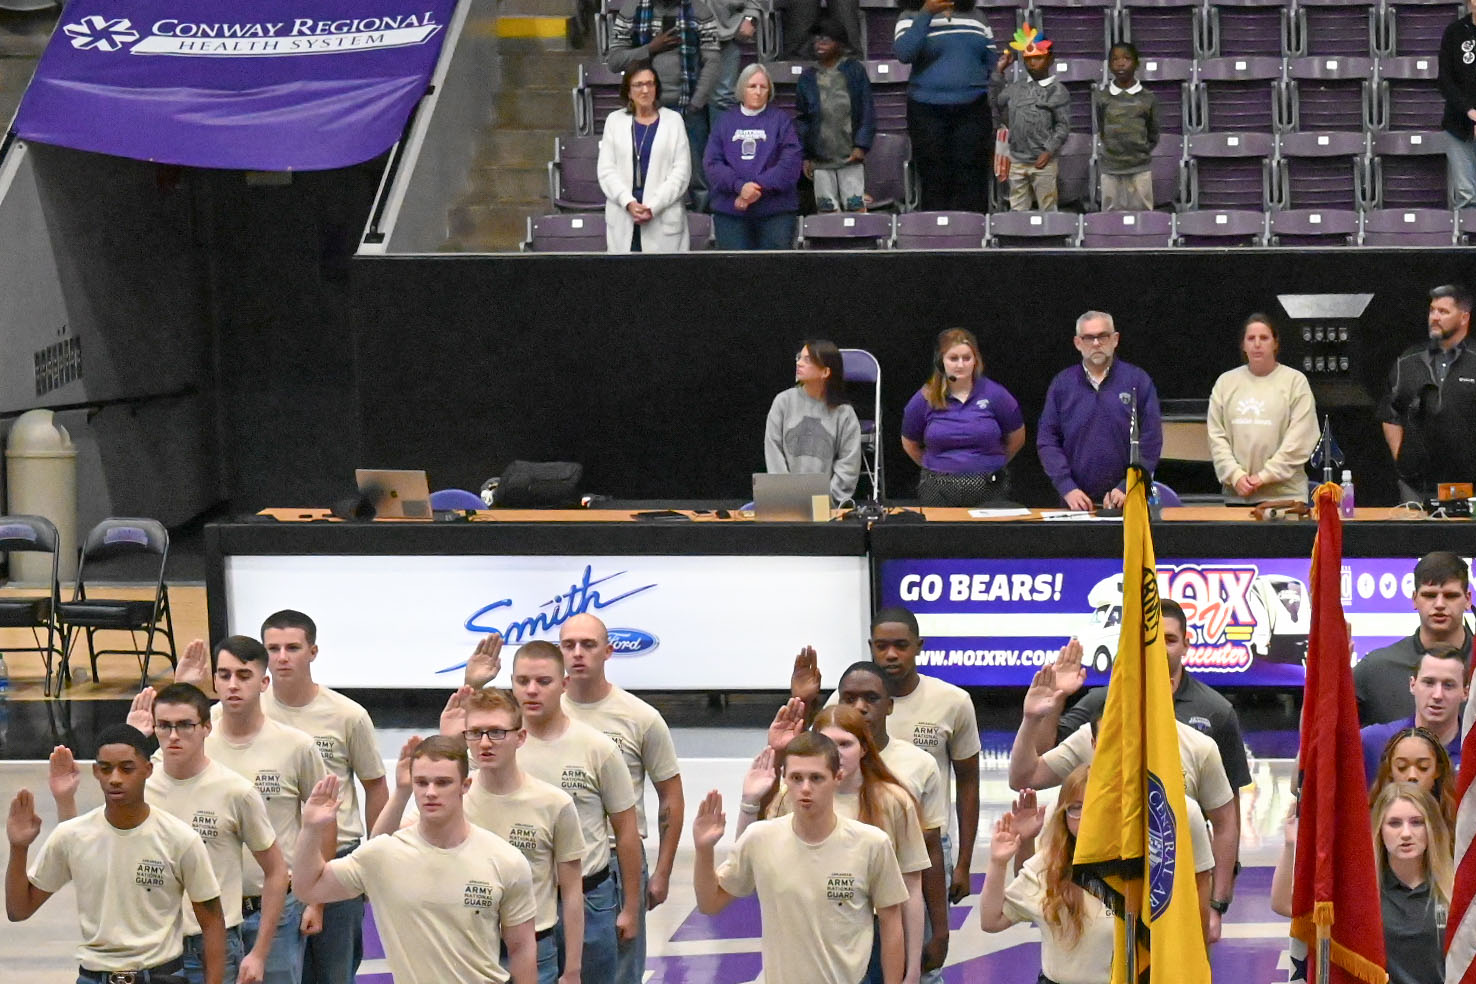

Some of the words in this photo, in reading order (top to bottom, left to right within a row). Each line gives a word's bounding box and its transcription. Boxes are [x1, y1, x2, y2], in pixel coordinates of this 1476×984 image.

[151, 18, 284, 37] CONWAY
[288, 11, 437, 36] REGIONAL
[178, 40, 280, 51] HEALTH
[289, 33, 386, 51] SYSTEM
[900, 574, 944, 601] GO
[949, 573, 1064, 601] BEARS!
[440, 565, 657, 672] Smith
[608, 633, 642, 650] Ford
[914, 649, 1061, 667] WW.MOIXRV.COM
[914, 726, 939, 735] ARMY
[913, 738, 939, 746] GUARD
[255, 774, 281, 782] ARMY
[561, 770, 587, 778] ARMY
[561, 781, 588, 789] GUARD
[192, 816, 218, 825] ARMY
[510, 828, 537, 837] ARMY
[137, 864, 165, 874] ARMY
[135, 877, 164, 886] GUARD
[465, 886, 493, 895] ARMY
[464, 898, 493, 907] GUARD
